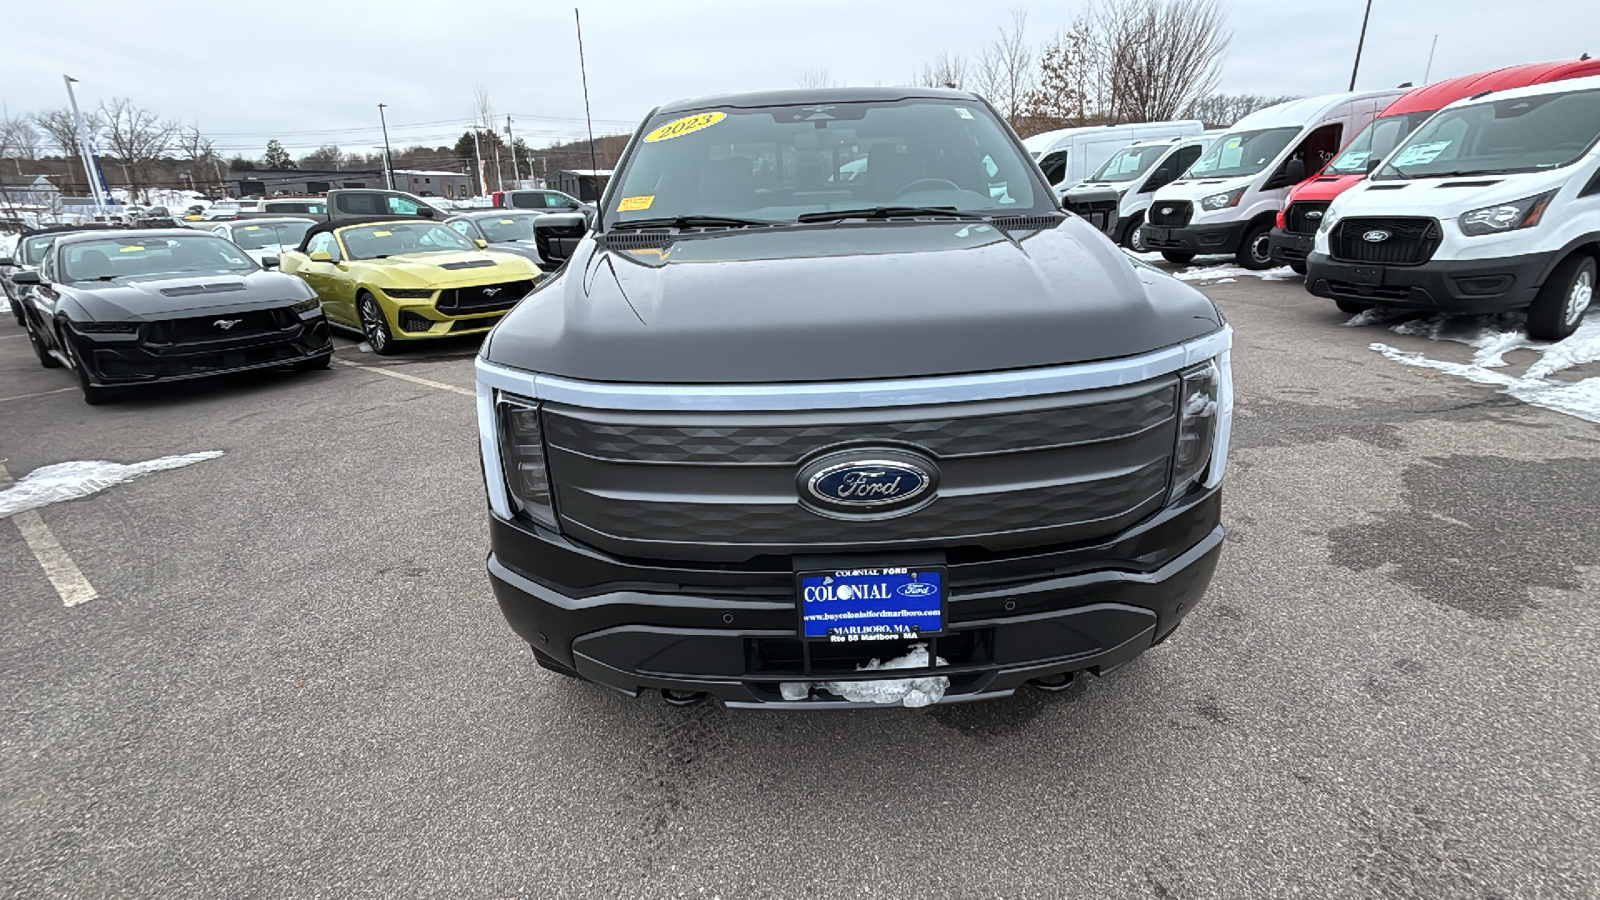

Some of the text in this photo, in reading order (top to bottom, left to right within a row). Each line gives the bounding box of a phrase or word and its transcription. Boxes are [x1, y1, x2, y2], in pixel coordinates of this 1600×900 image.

[658, 114, 713, 139] 2023
[837, 471, 901, 498] Ford
[835, 567, 907, 577] COLONIAL FORD
[804, 583, 929, 602] COLONIAL Ford
[803, 610, 941, 622] www.buycolonialfordmarlboro.com
[893, 624, 910, 632] MA
